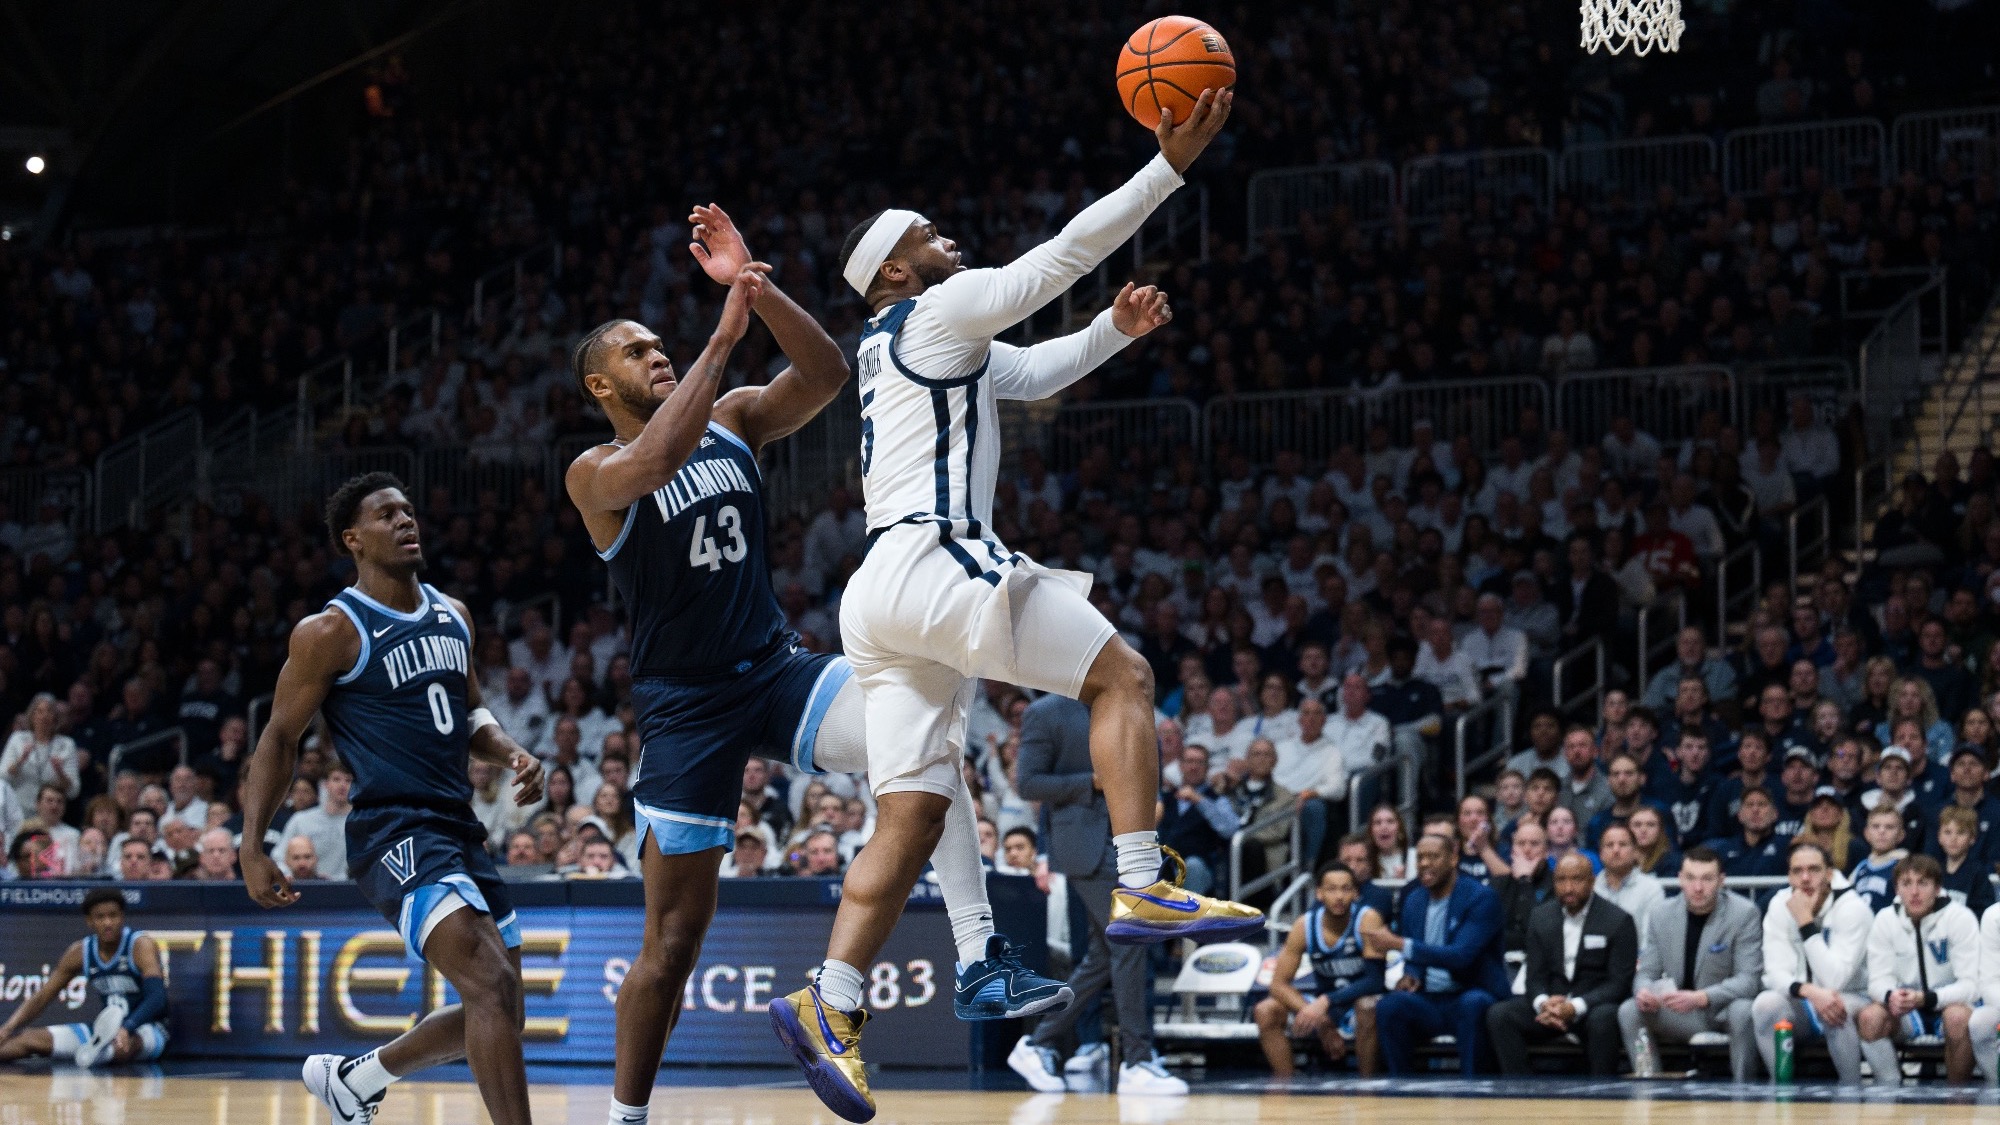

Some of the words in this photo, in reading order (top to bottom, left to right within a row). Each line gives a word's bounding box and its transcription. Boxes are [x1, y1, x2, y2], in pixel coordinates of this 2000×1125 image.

[653, 458, 753, 524] VILLANOVA
[689, 505, 748, 572] 43
[427, 682, 454, 736] 0
[381, 836, 417, 886] V
[0, 888, 91, 904] FIELDHOUS
[0, 963, 88, 1010] ionig
[603, 957, 776, 1012] SCE
